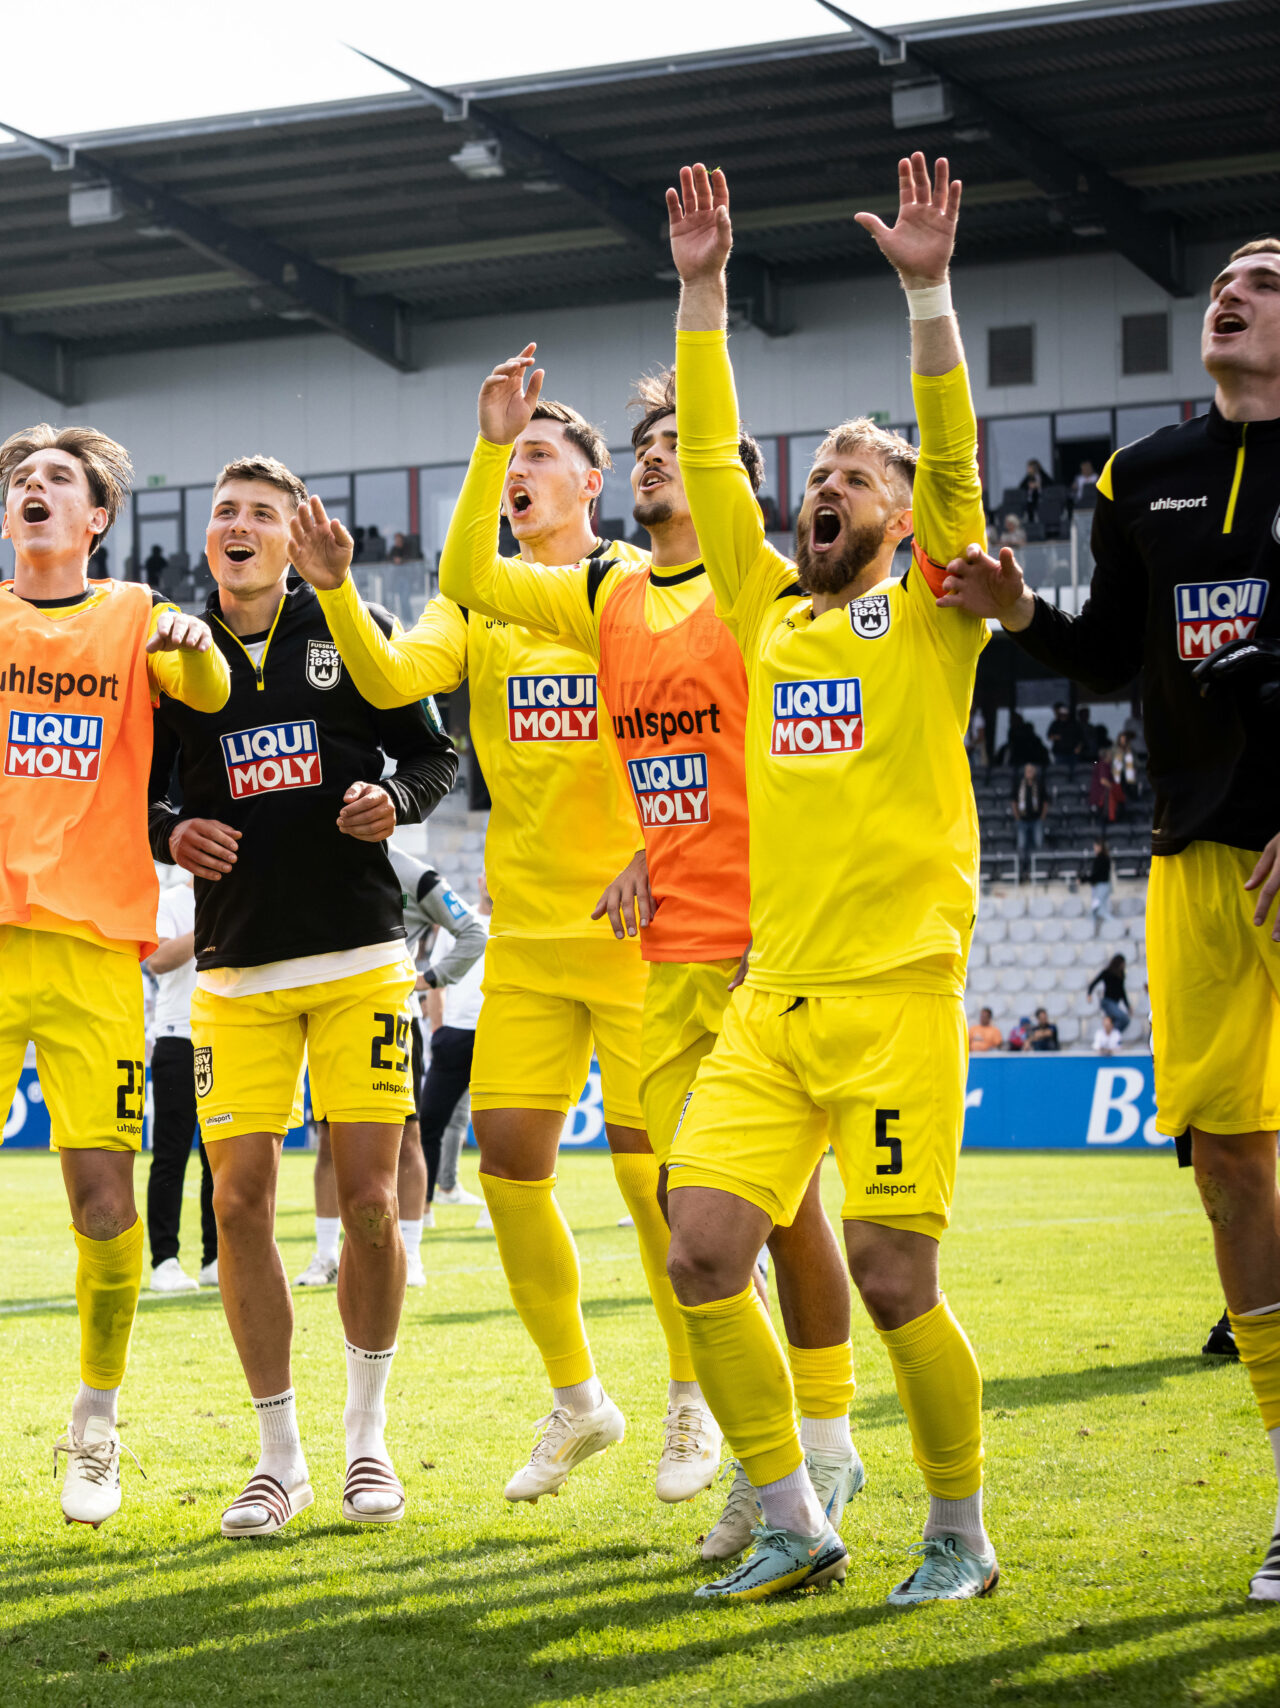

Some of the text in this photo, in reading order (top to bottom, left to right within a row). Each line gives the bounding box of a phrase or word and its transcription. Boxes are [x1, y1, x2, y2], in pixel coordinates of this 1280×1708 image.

[1150, 495, 1208, 511] uhlsport
[851, 600, 886, 608] SSV
[852, 607, 887, 616] 1846
[1181, 583, 1262, 619] LIQUI
[309, 657, 339, 667] 1846
[310, 649, 339, 658] SSV
[513, 678, 594, 707] LIQUI
[776, 682, 856, 717] LIQUI
[11, 714, 99, 747] LIQUI
[514, 710, 596, 738] MOLY
[775, 718, 860, 752] MOLY
[226, 724, 313, 764] LIQUI
[8, 746, 99, 778] MOLY
[233, 755, 317, 795] MOLY
[631, 757, 704, 791] LIQUI
[640, 790, 707, 823] MOLY
[371, 1012, 410, 1073] 29
[117, 1060, 144, 1121] 23
[206, 1113, 231, 1124] uhlsport
[875, 1109, 903, 1175] 5
[865, 1182, 917, 1197] uhlsport
